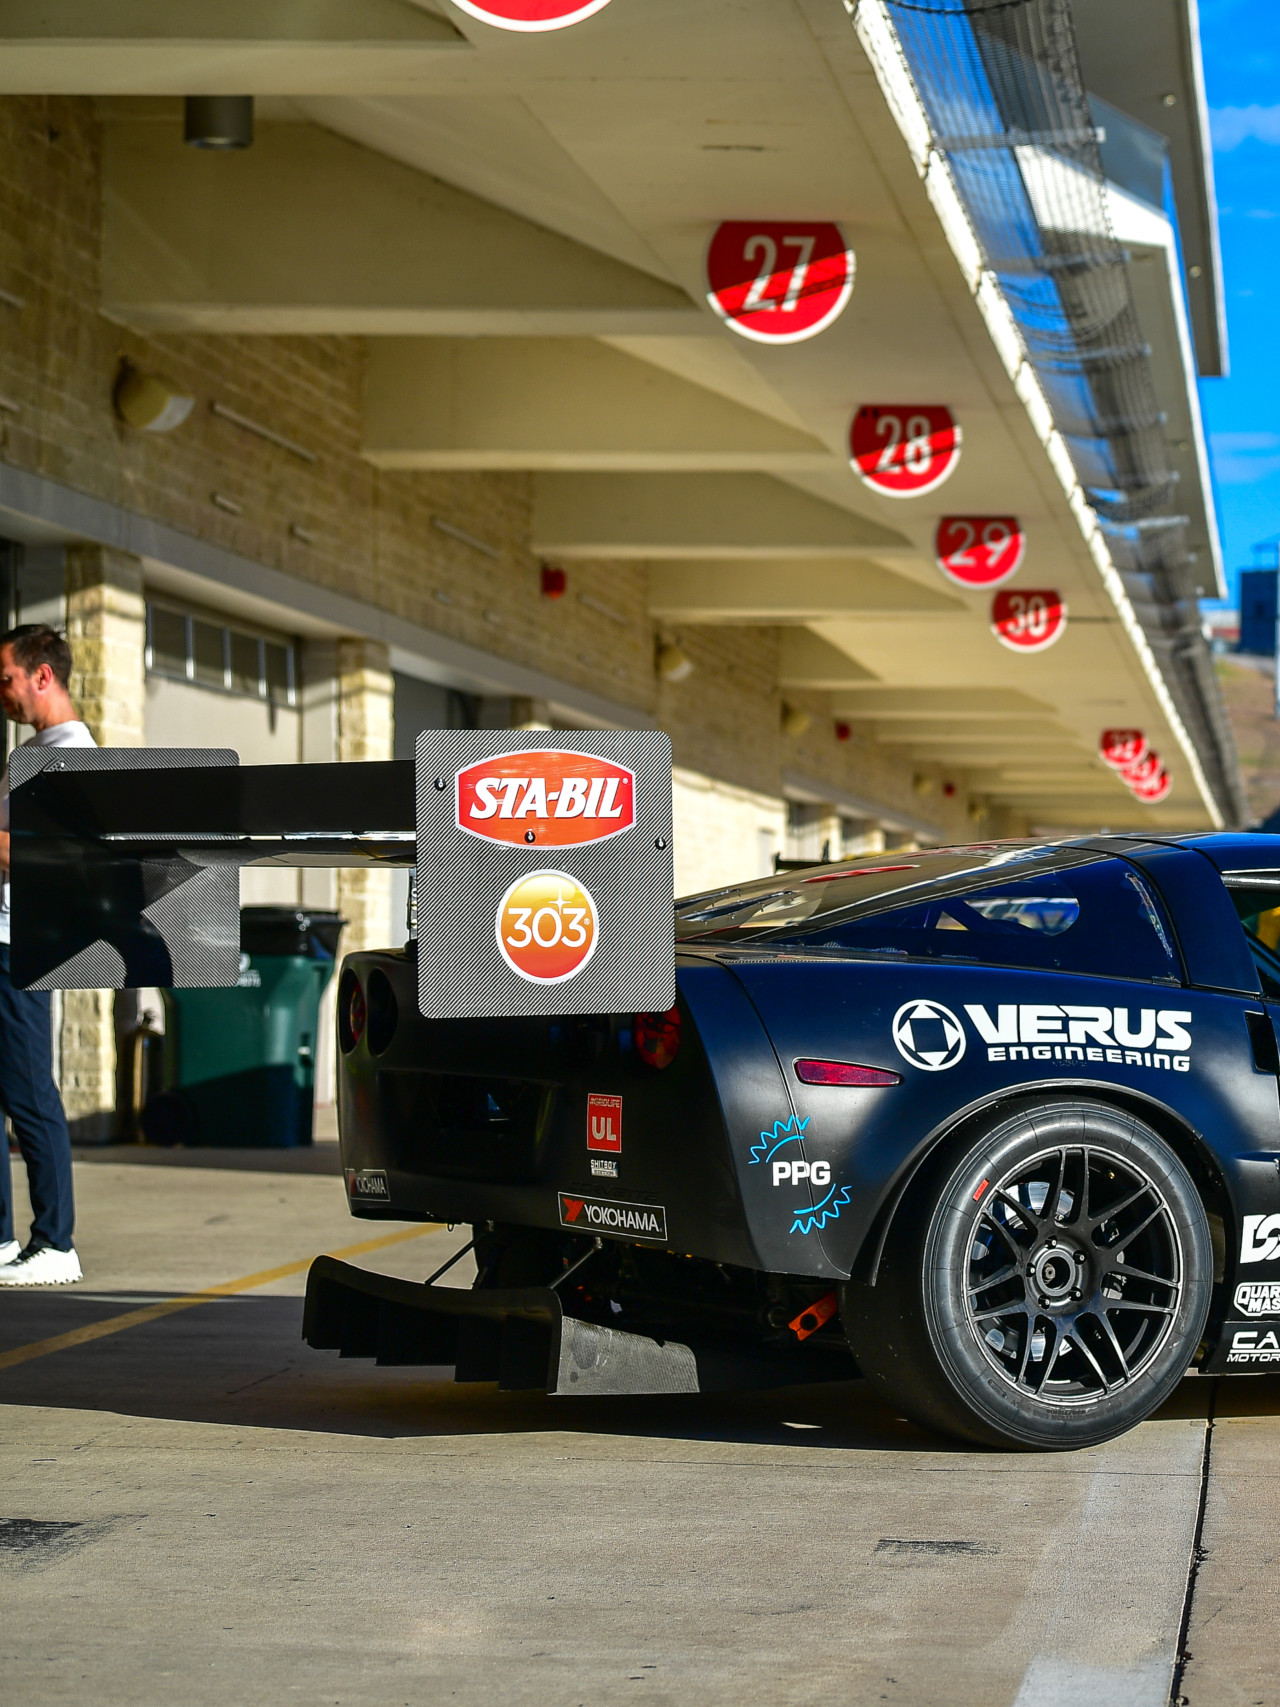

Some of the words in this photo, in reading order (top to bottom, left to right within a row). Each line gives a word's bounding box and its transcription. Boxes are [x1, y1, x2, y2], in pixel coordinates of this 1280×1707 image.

[742, 234, 816, 313] 27
[875, 415, 934, 474] 28
[947, 521, 1012, 567] 29
[1006, 595, 1048, 638] 30
[469, 777, 624, 819] STA-BIL
[506, 907, 588, 948] 303
[963, 1003, 1192, 1052] VERUS
[987, 1046, 1191, 1073] ENGINEERING
[591, 1116, 617, 1141] UL
[772, 1160, 831, 1186] PPG
[583, 1204, 660, 1232] YOKOHAMA
